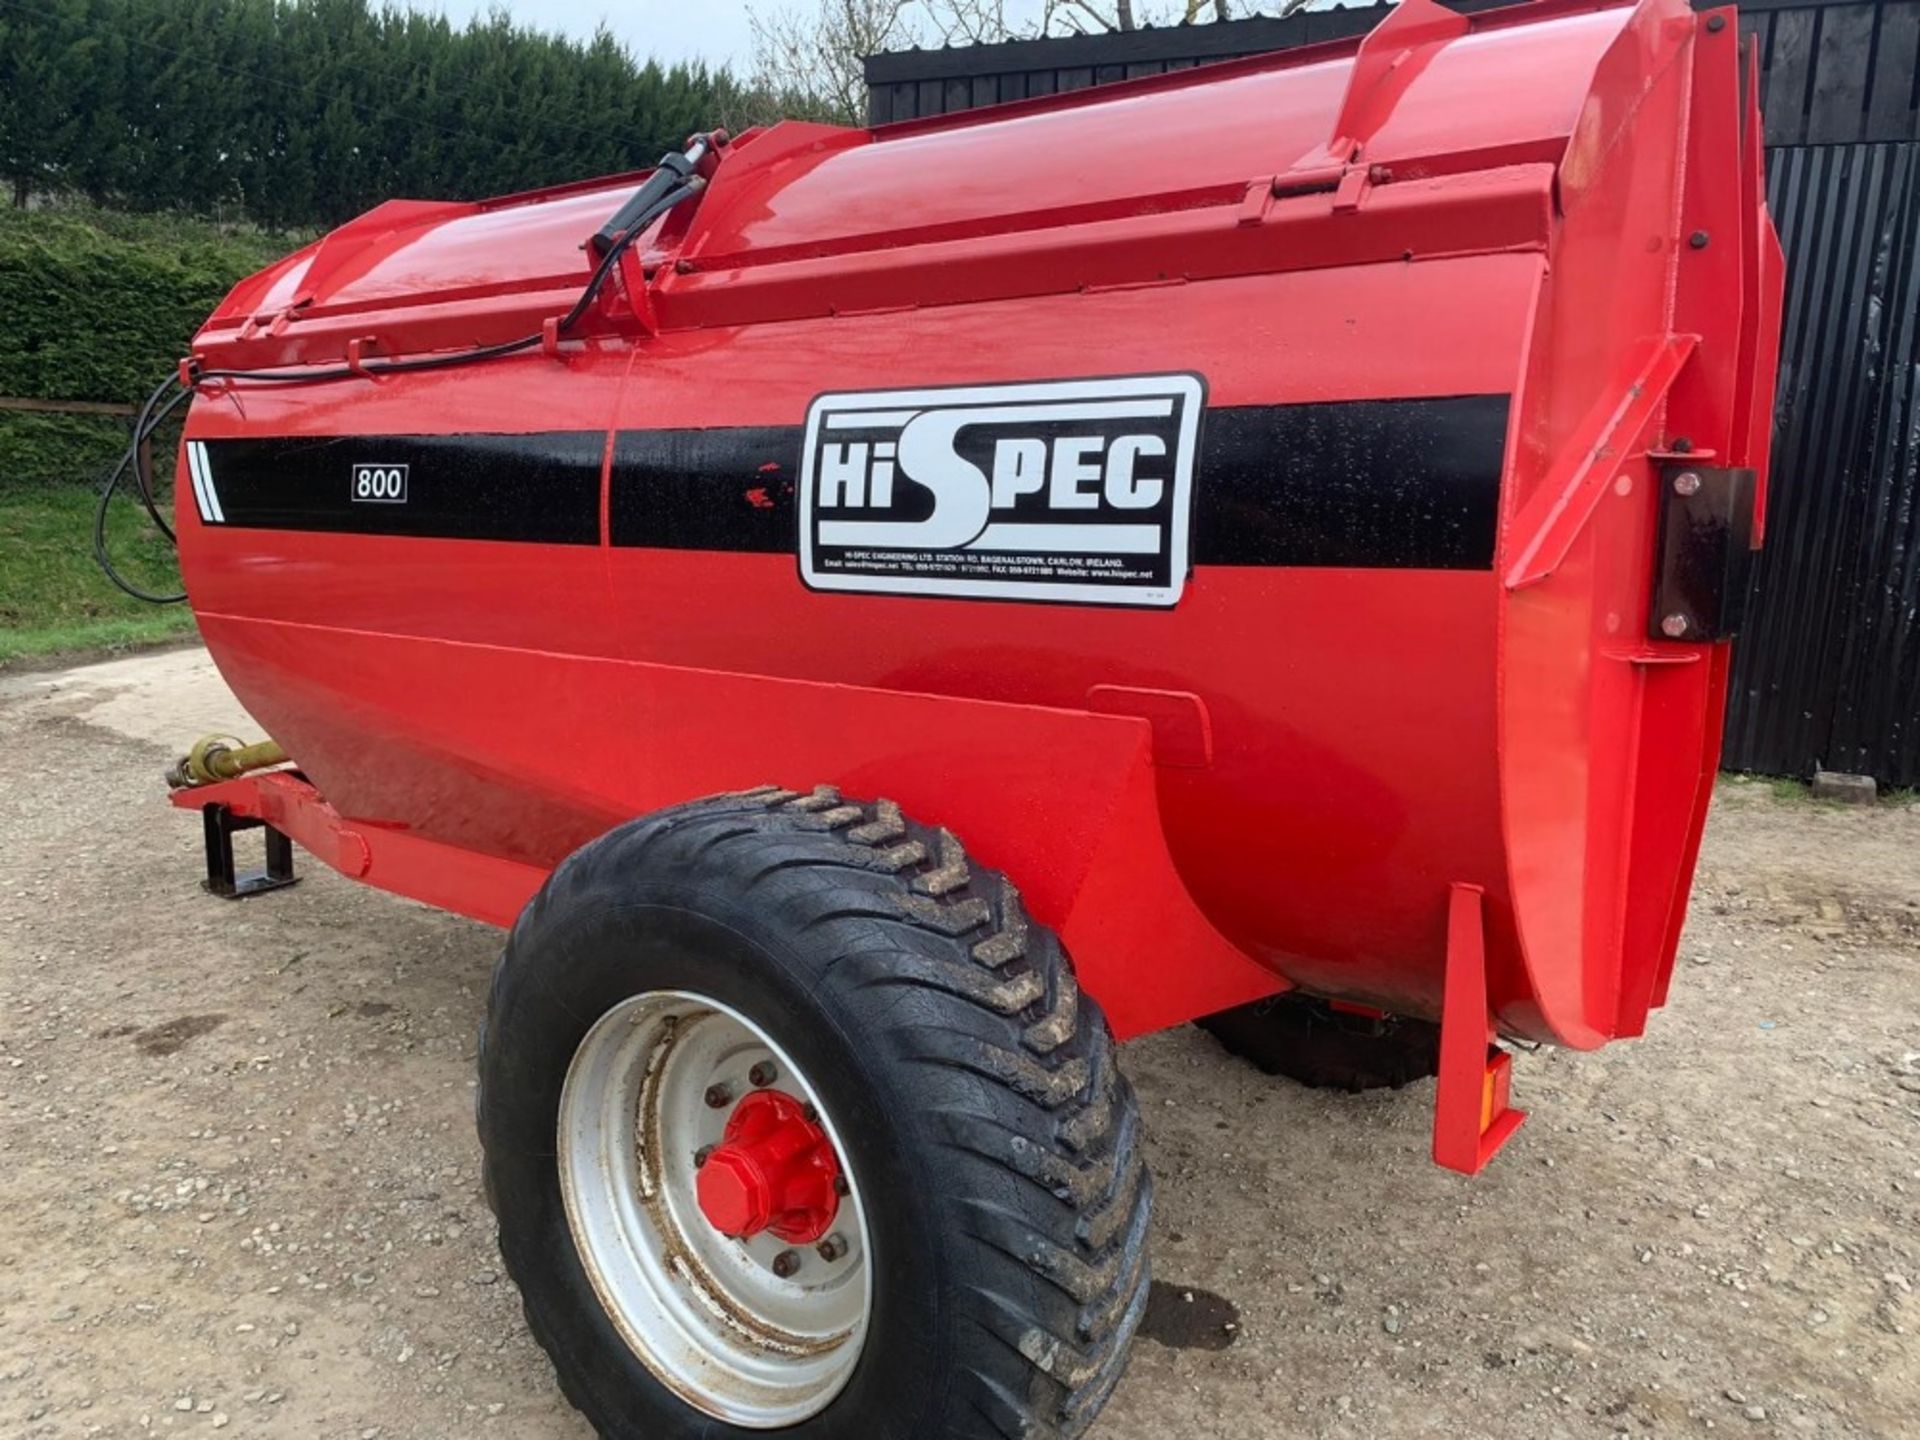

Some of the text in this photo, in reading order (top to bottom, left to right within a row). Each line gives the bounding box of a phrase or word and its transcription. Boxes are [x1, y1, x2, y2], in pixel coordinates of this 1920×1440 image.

[358, 469, 401, 497] 800
[872, 552, 918, 562] ENGINEERING
[936, 554, 964, 563] STATION
[1091, 569, 1153, 579] www.hispec.net
